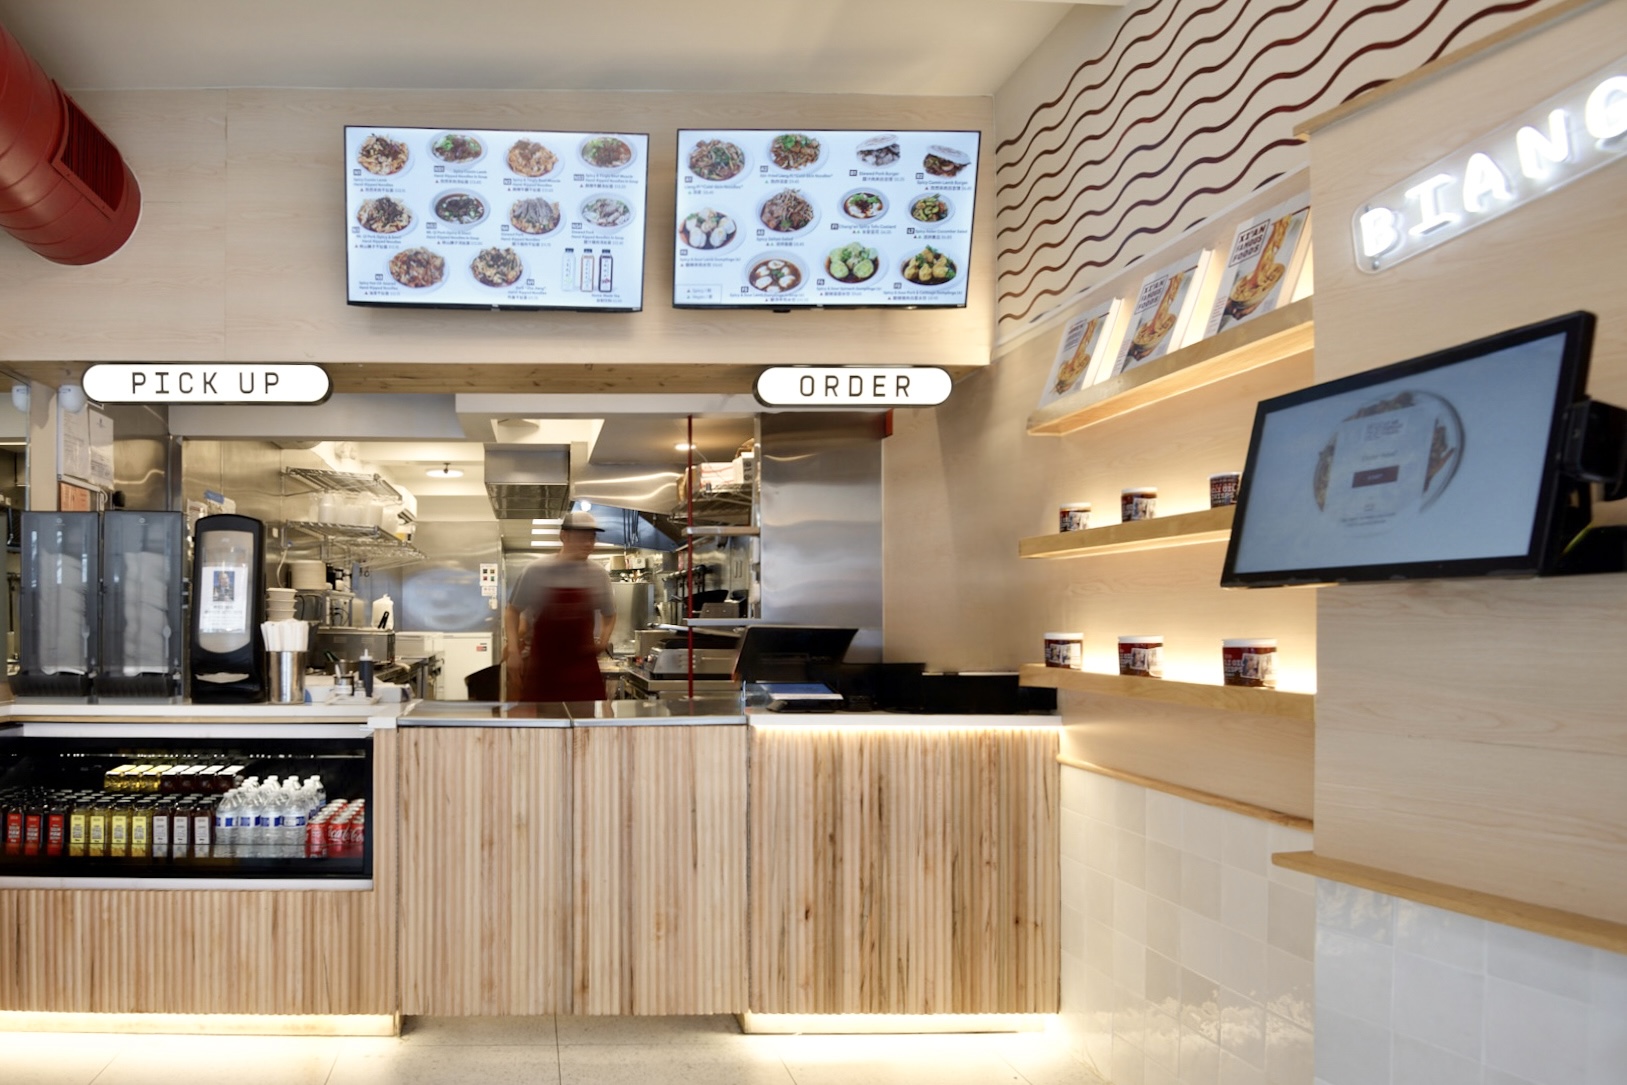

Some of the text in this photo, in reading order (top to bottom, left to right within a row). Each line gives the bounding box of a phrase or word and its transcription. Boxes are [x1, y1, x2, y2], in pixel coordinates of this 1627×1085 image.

[132, 372, 280, 394] PICK UP
[800, 375, 910, 397] ORDER
